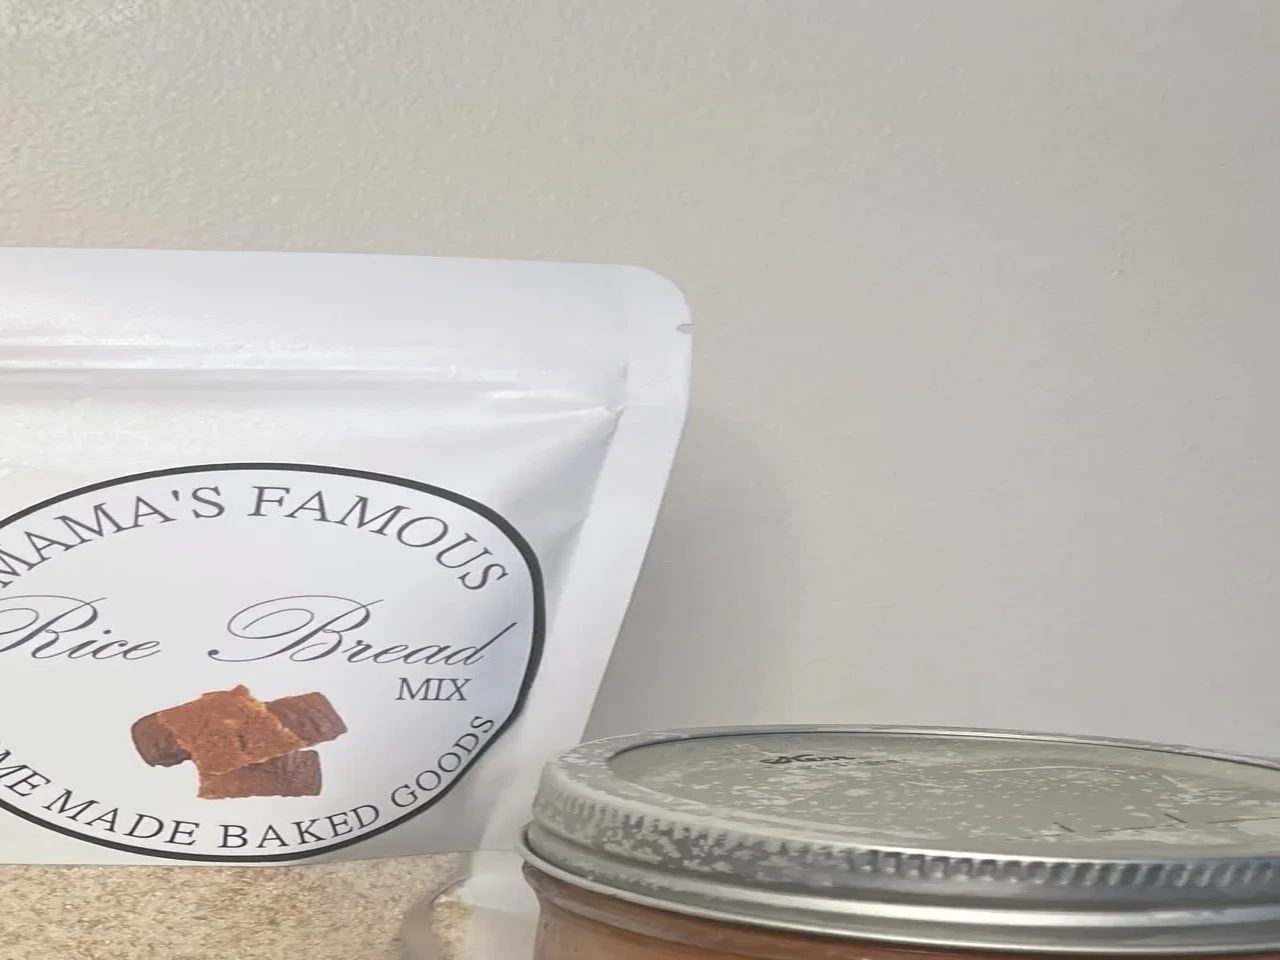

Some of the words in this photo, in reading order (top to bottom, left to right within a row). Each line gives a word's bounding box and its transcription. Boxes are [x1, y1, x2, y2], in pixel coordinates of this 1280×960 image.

[246, 484, 511, 592] FAMOUS
[207, 595, 518, 666] Bread
[395, 677, 472, 702] MIX
[41, 788, 200, 846] MADE
[218, 804, 380, 848] BAKED
[390, 715, 495, 808] GOODS
